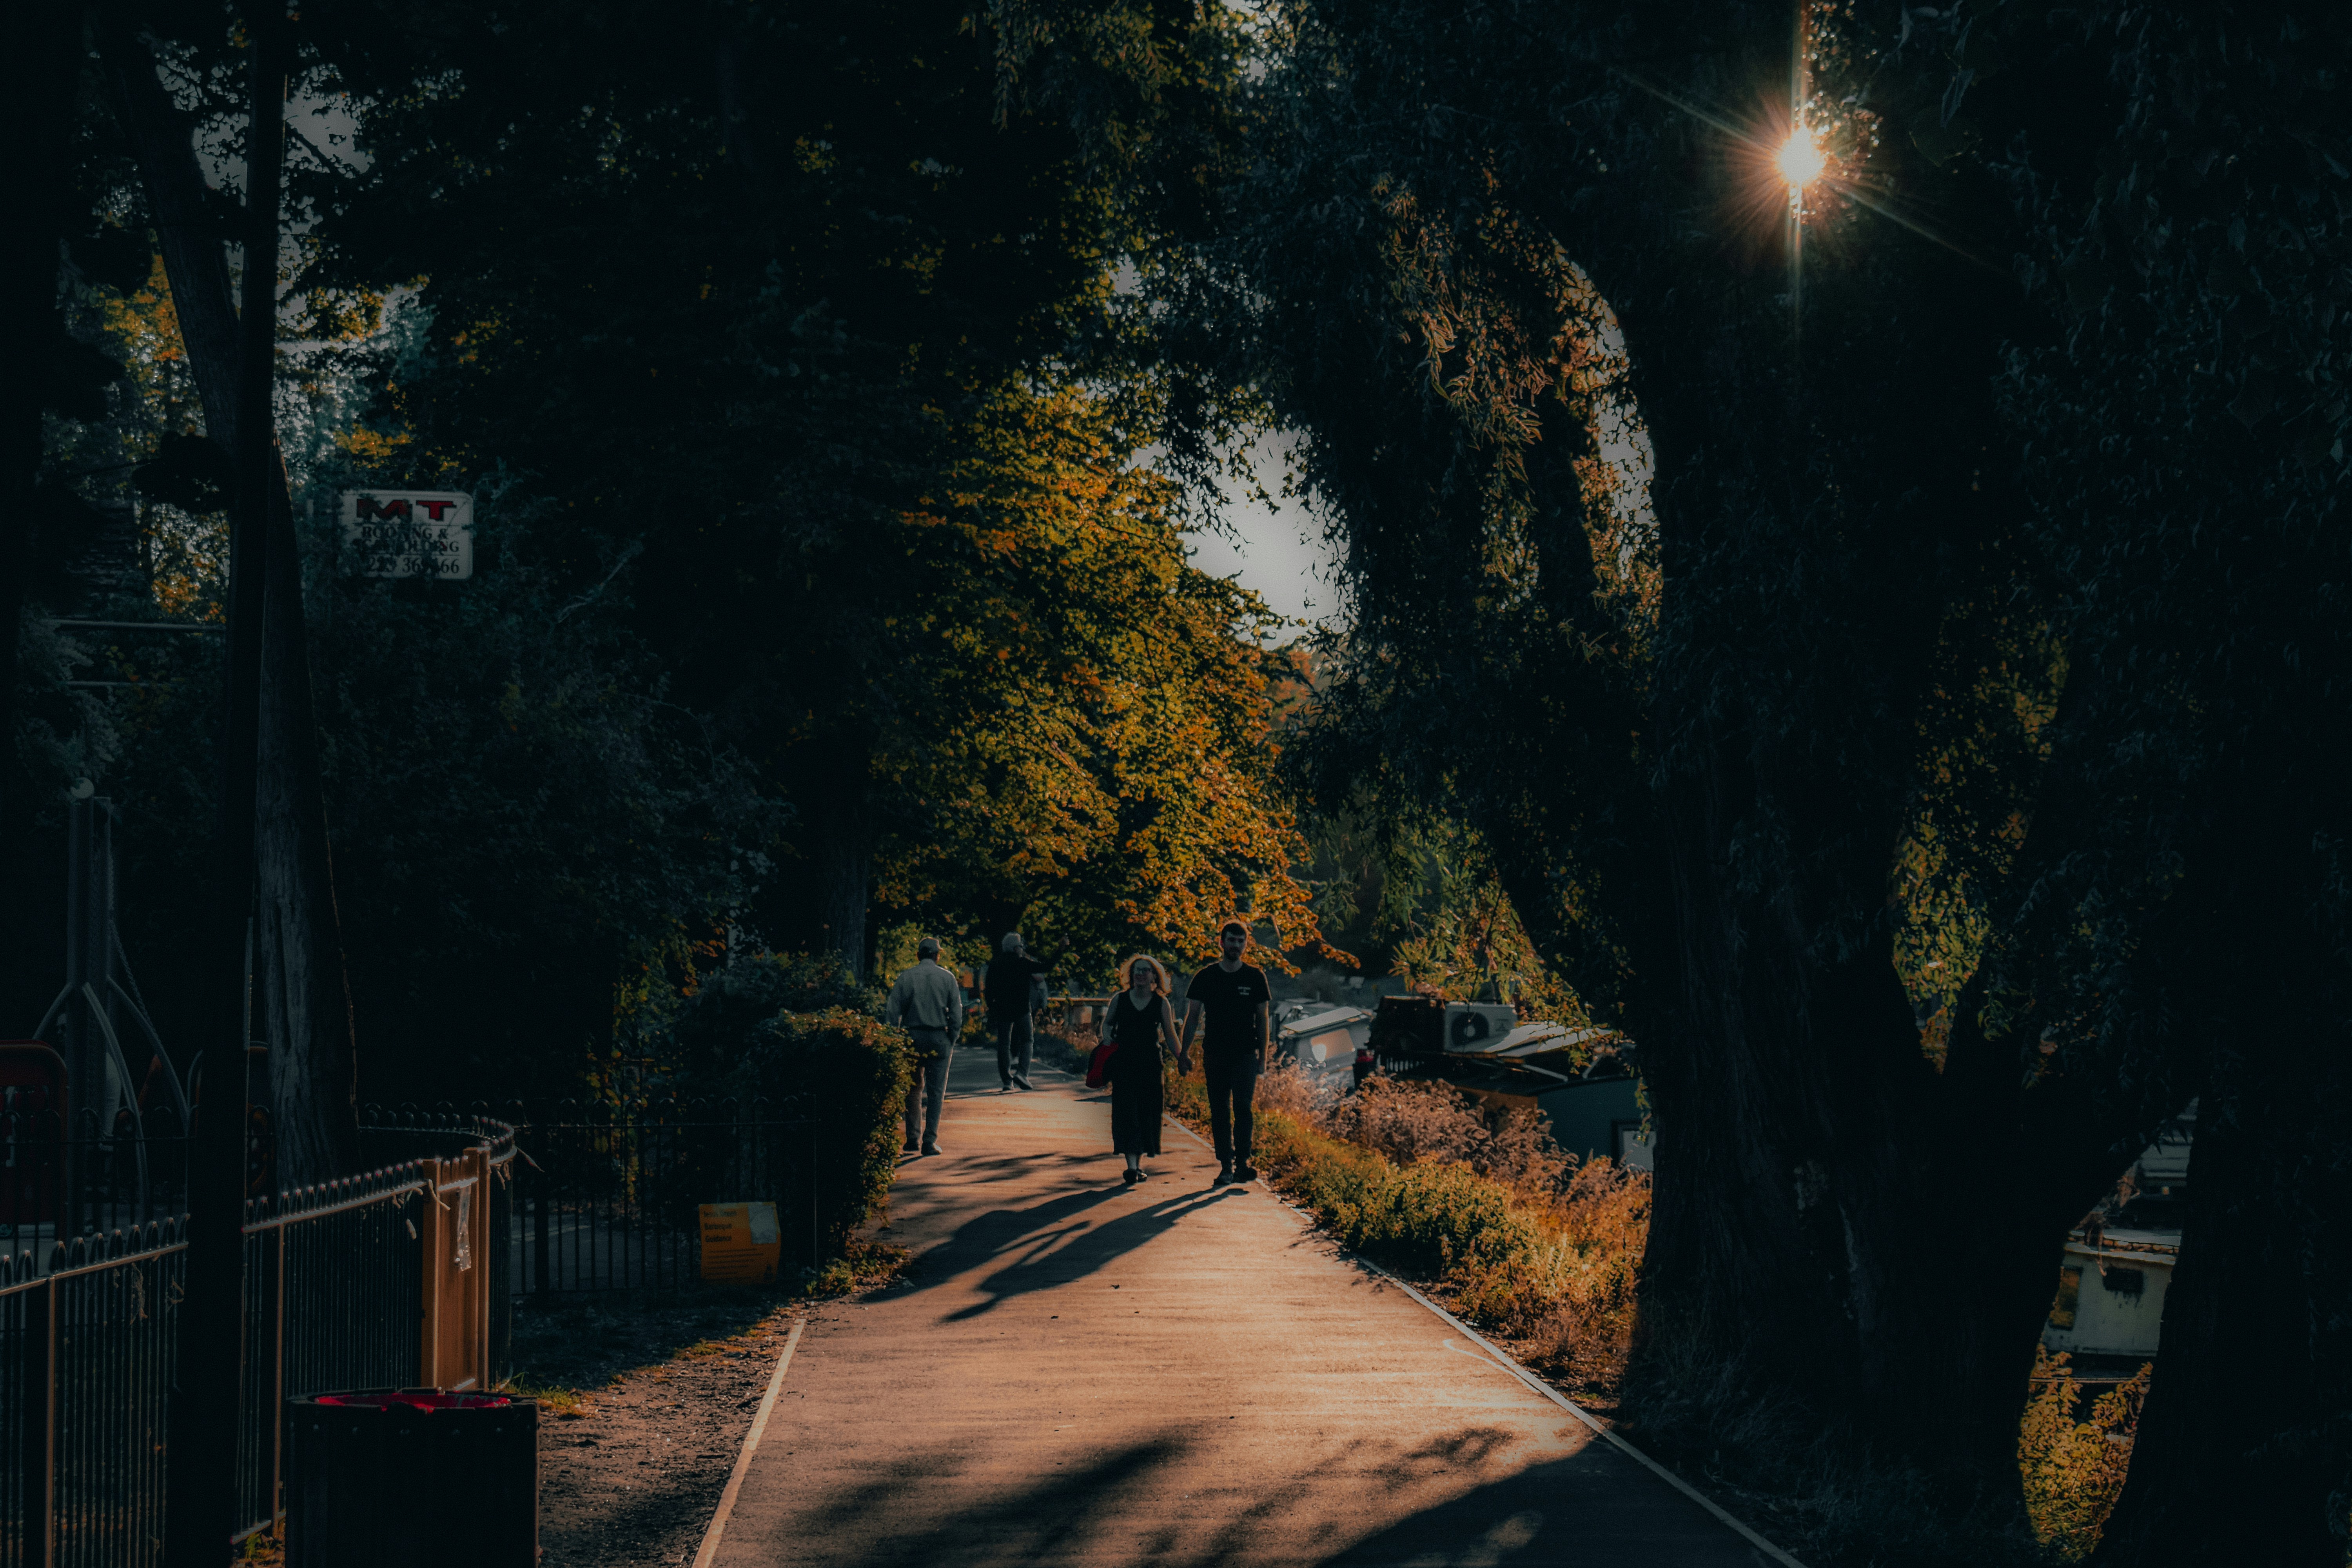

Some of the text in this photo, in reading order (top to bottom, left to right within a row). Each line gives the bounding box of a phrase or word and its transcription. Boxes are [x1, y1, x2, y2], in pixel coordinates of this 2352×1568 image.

[356, 499, 457, 521] MT
[361, 526, 448, 539] ROONG &
